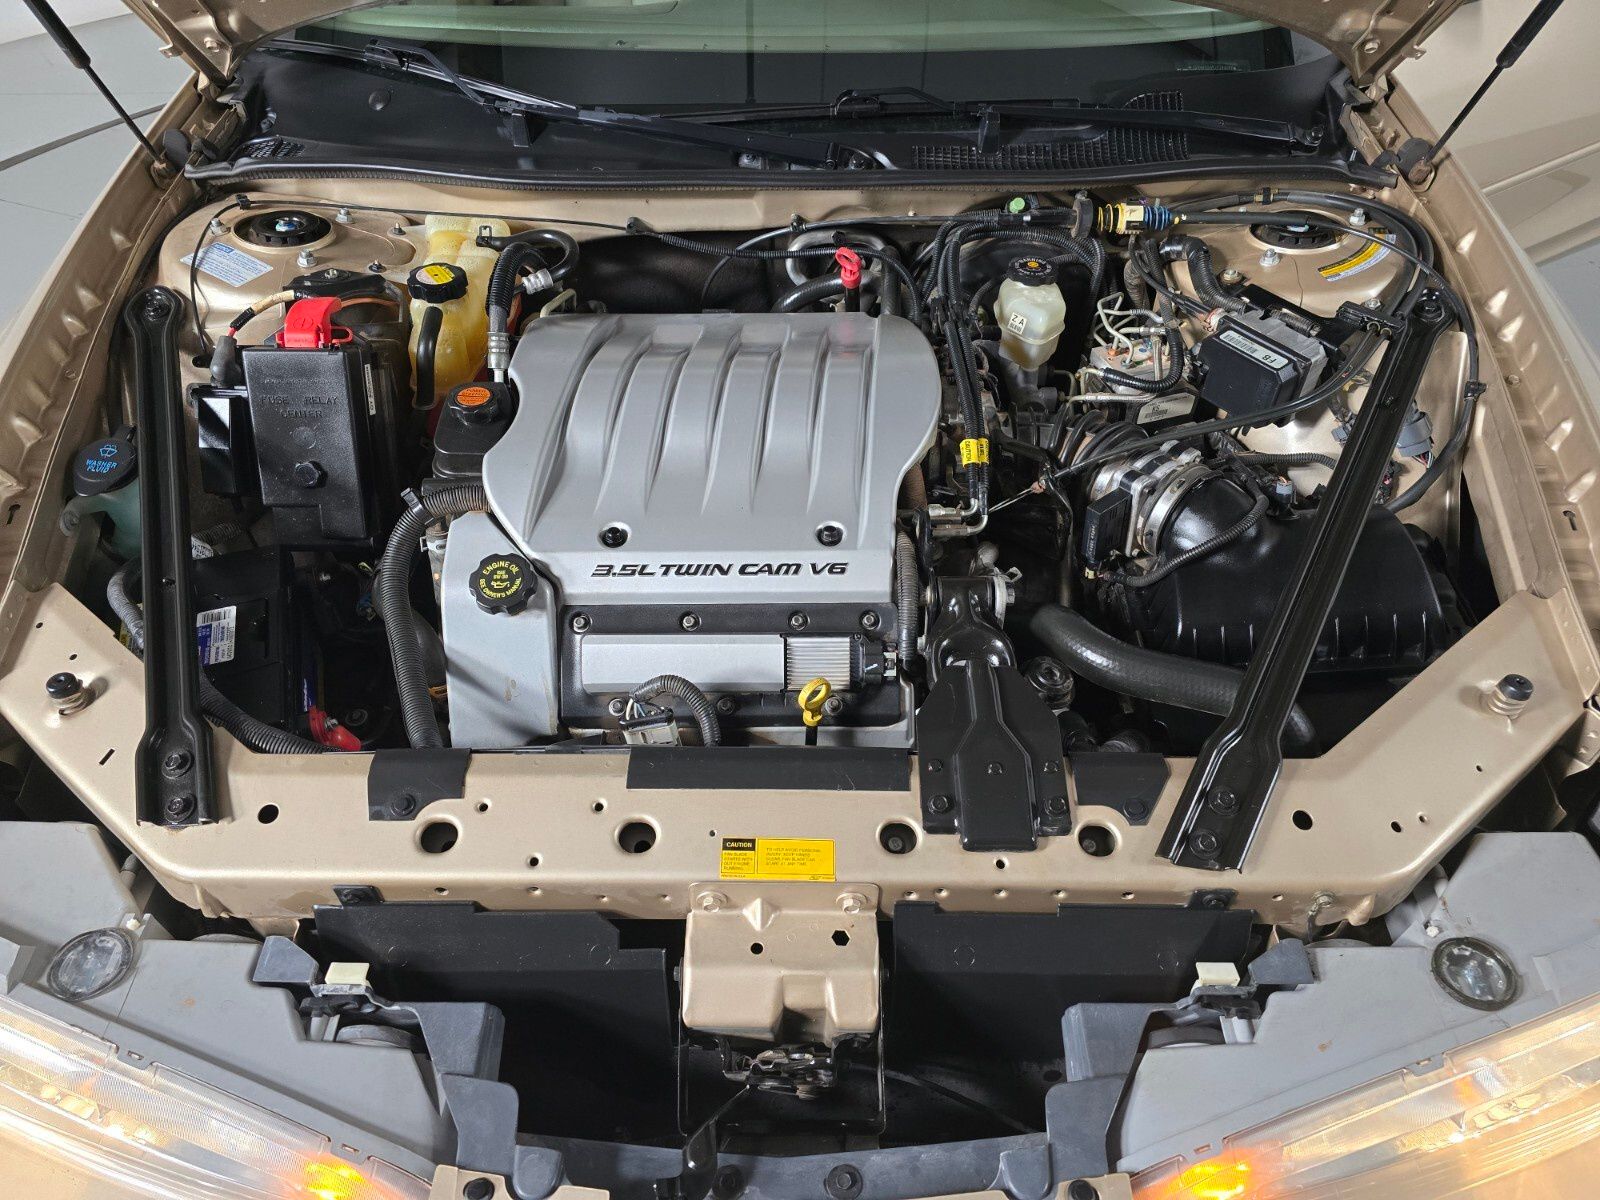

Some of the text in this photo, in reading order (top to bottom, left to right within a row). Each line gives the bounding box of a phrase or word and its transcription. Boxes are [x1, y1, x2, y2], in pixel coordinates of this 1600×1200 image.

[261, 395, 338, 405] FUSE RELAY
[280, 410, 323, 419] CENTER
[86, 459, 117, 469] WASHER
[86, 465, 110, 473] FLUID
[482, 561, 510, 575] ENGINE
[591, 562, 849, 578] 3.5L TWIN CAM V6
